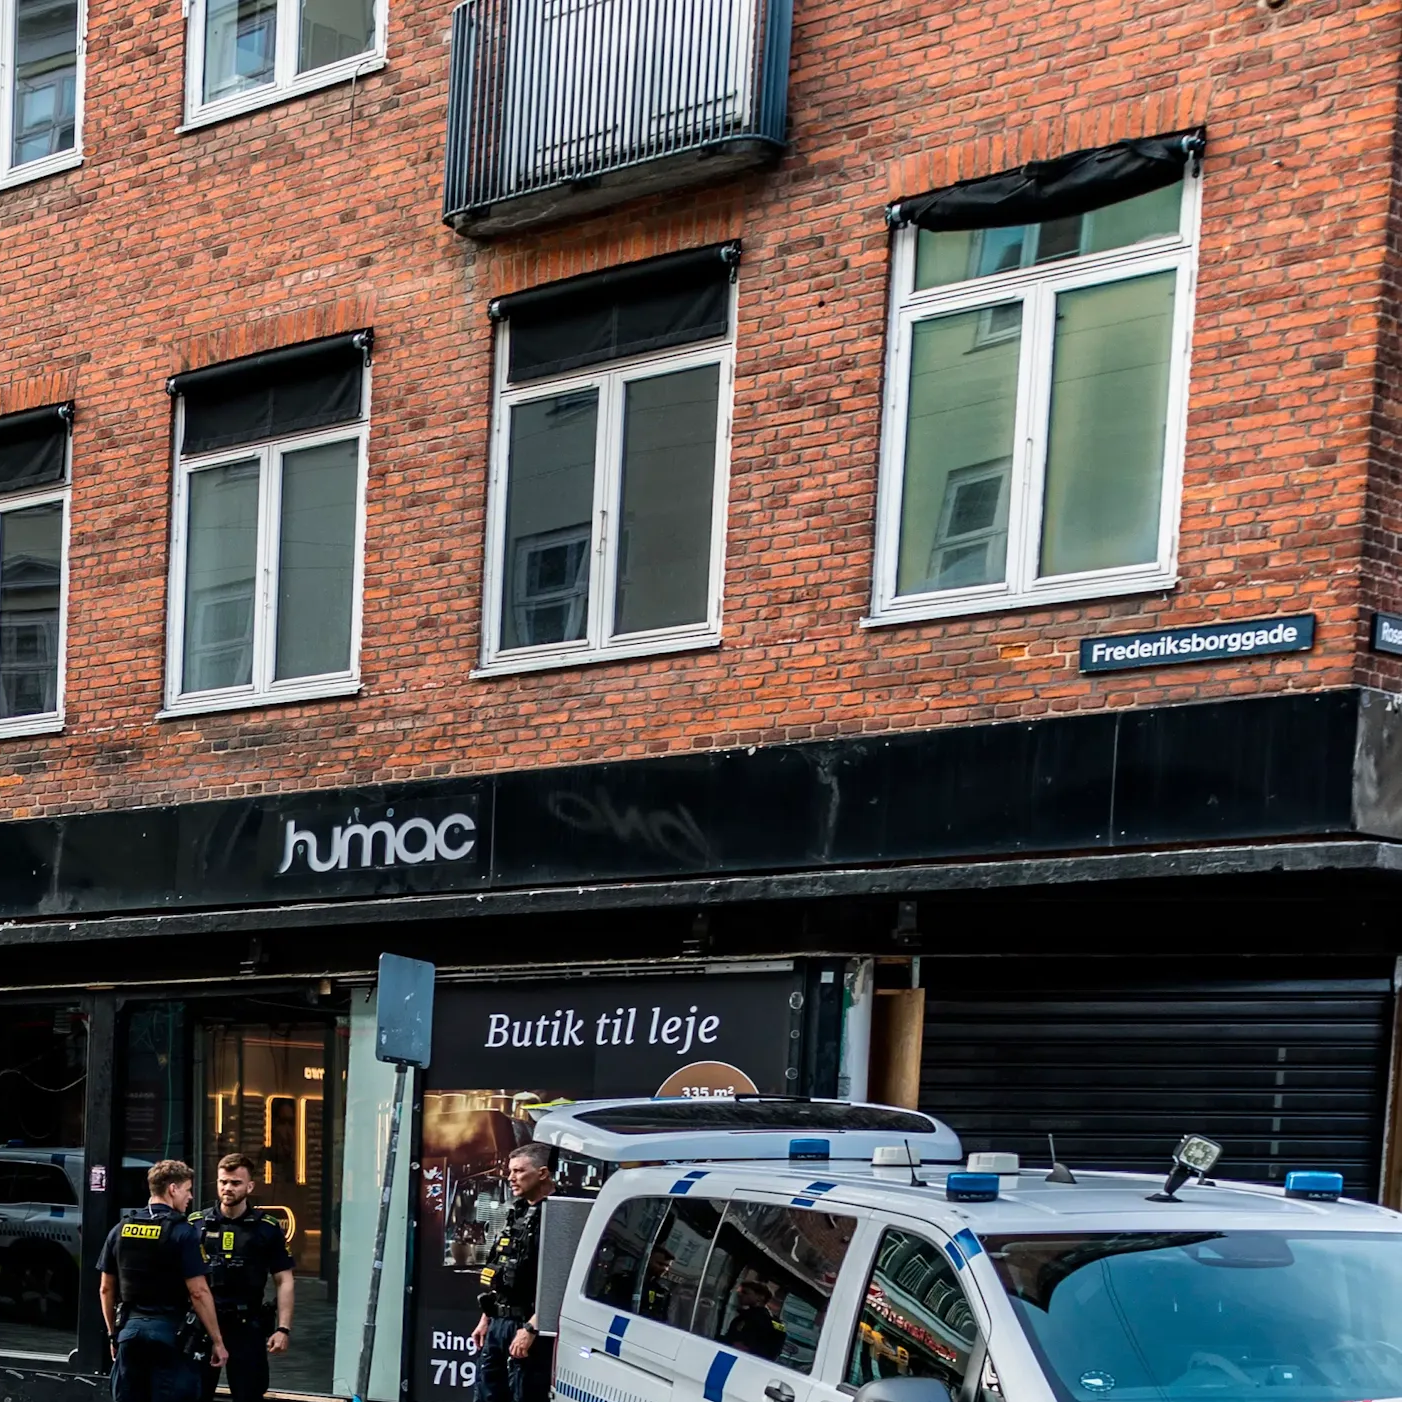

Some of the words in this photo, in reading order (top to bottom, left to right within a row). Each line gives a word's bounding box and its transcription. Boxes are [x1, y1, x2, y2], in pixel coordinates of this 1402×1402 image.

[1091, 624, 1298, 664] Frederiksborggade
[279, 813, 477, 874] humac
[484, 1009, 585, 1048] Butik
[595, 1007, 638, 1046] til
[647, 1005, 721, 1055] leje
[681, 1086, 709, 1099] 335
[122, 1225, 160, 1238] POLITI
[432, 1331, 479, 1356] Ring
